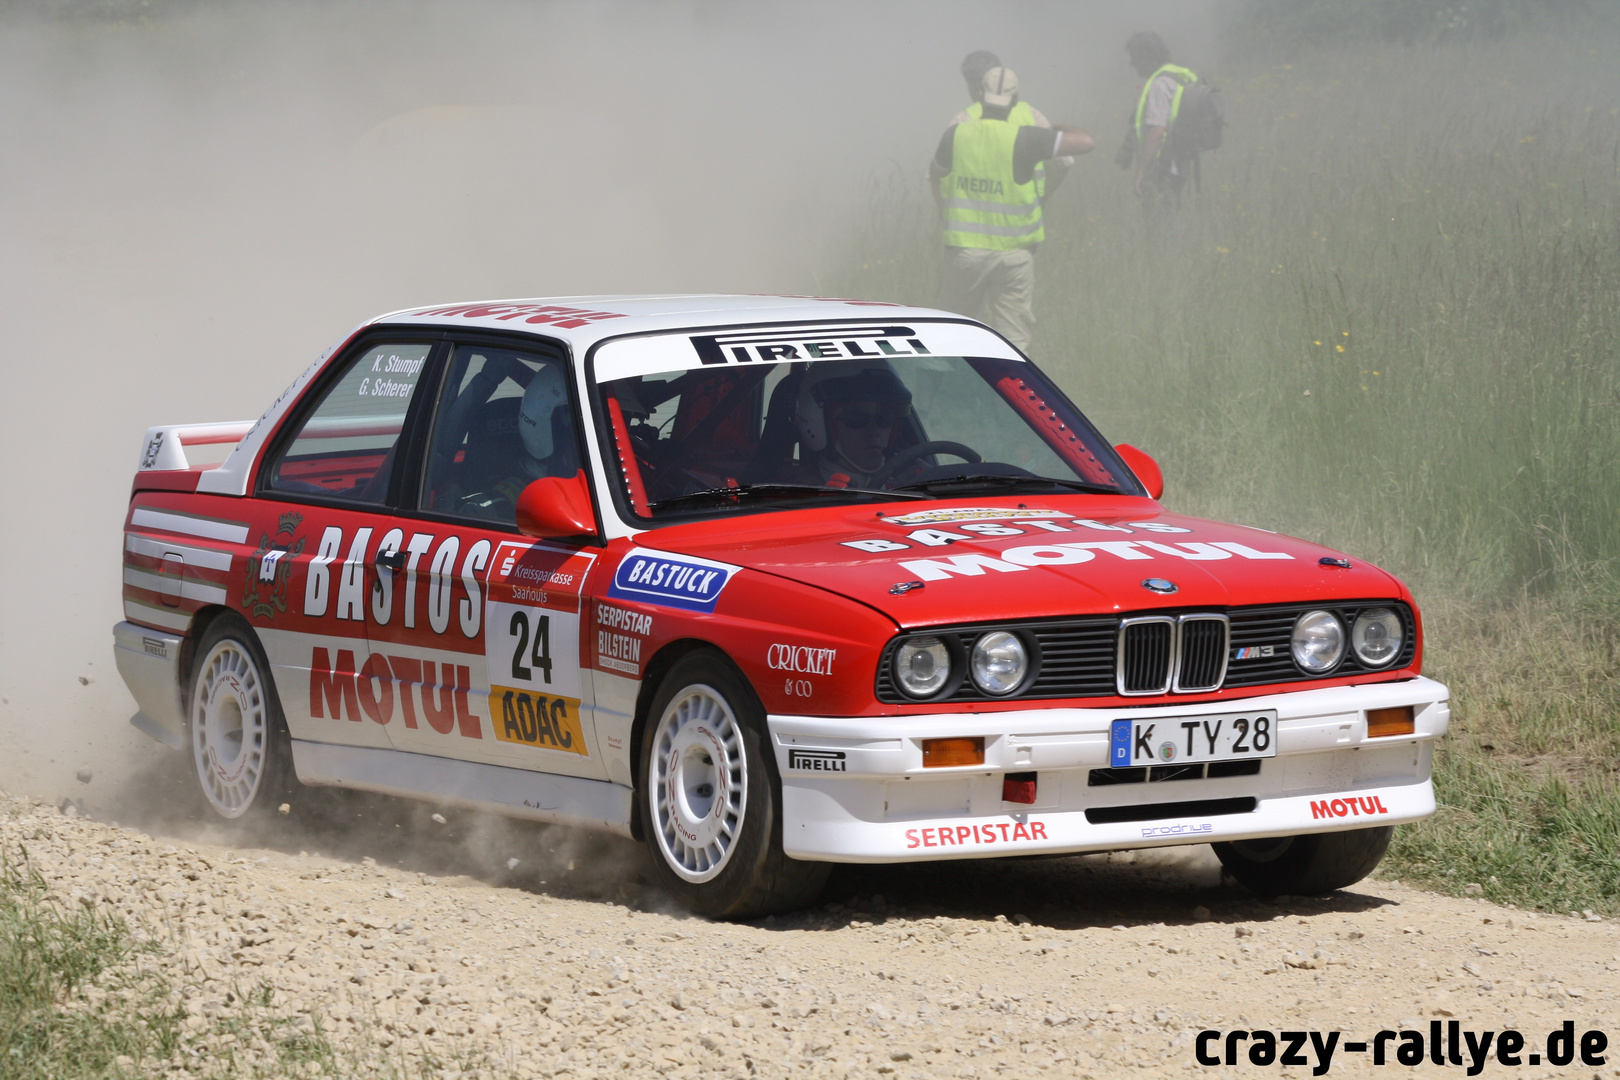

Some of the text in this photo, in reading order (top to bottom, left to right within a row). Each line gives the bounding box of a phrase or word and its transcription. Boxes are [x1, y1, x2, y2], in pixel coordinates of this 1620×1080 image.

[956, 176, 1004, 196] MEDIA
[689, 326, 932, 365] PIRELLI
[371, 354, 425, 377] K. Stumpf
[358, 377, 414, 398] G. Scherer
[839, 519, 1193, 553] BASTOS
[514, 564, 573, 586] Kreissparkasse
[627, 559, 719, 594] BASTUCK
[897, 540, 1296, 582] MOTUL
[303, 526, 491, 640] BASTOS
[597, 603, 653, 636] SERPISTAR
[142, 636, 167, 657] PIRELLI
[509, 610, 553, 684] 24
[598, 630, 641, 662] BILSTEIN
[767, 643, 837, 676] CRICKET
[1247, 645, 1275, 659] M3
[309, 646, 483, 739] MOTUL
[784, 678, 813, 698] & CO
[502, 690, 573, 749] ADAC
[1117, 747, 1126, 758] D
[1134, 716, 1270, 760] K TY 28
[788, 749, 847, 772] PIRELLI
[670, 805, 698, 841] RACING
[1309, 795, 1388, 820] MOTUL
[905, 821, 1049, 849] SERPISTAR
[1141, 823, 1213, 838] prodrive
